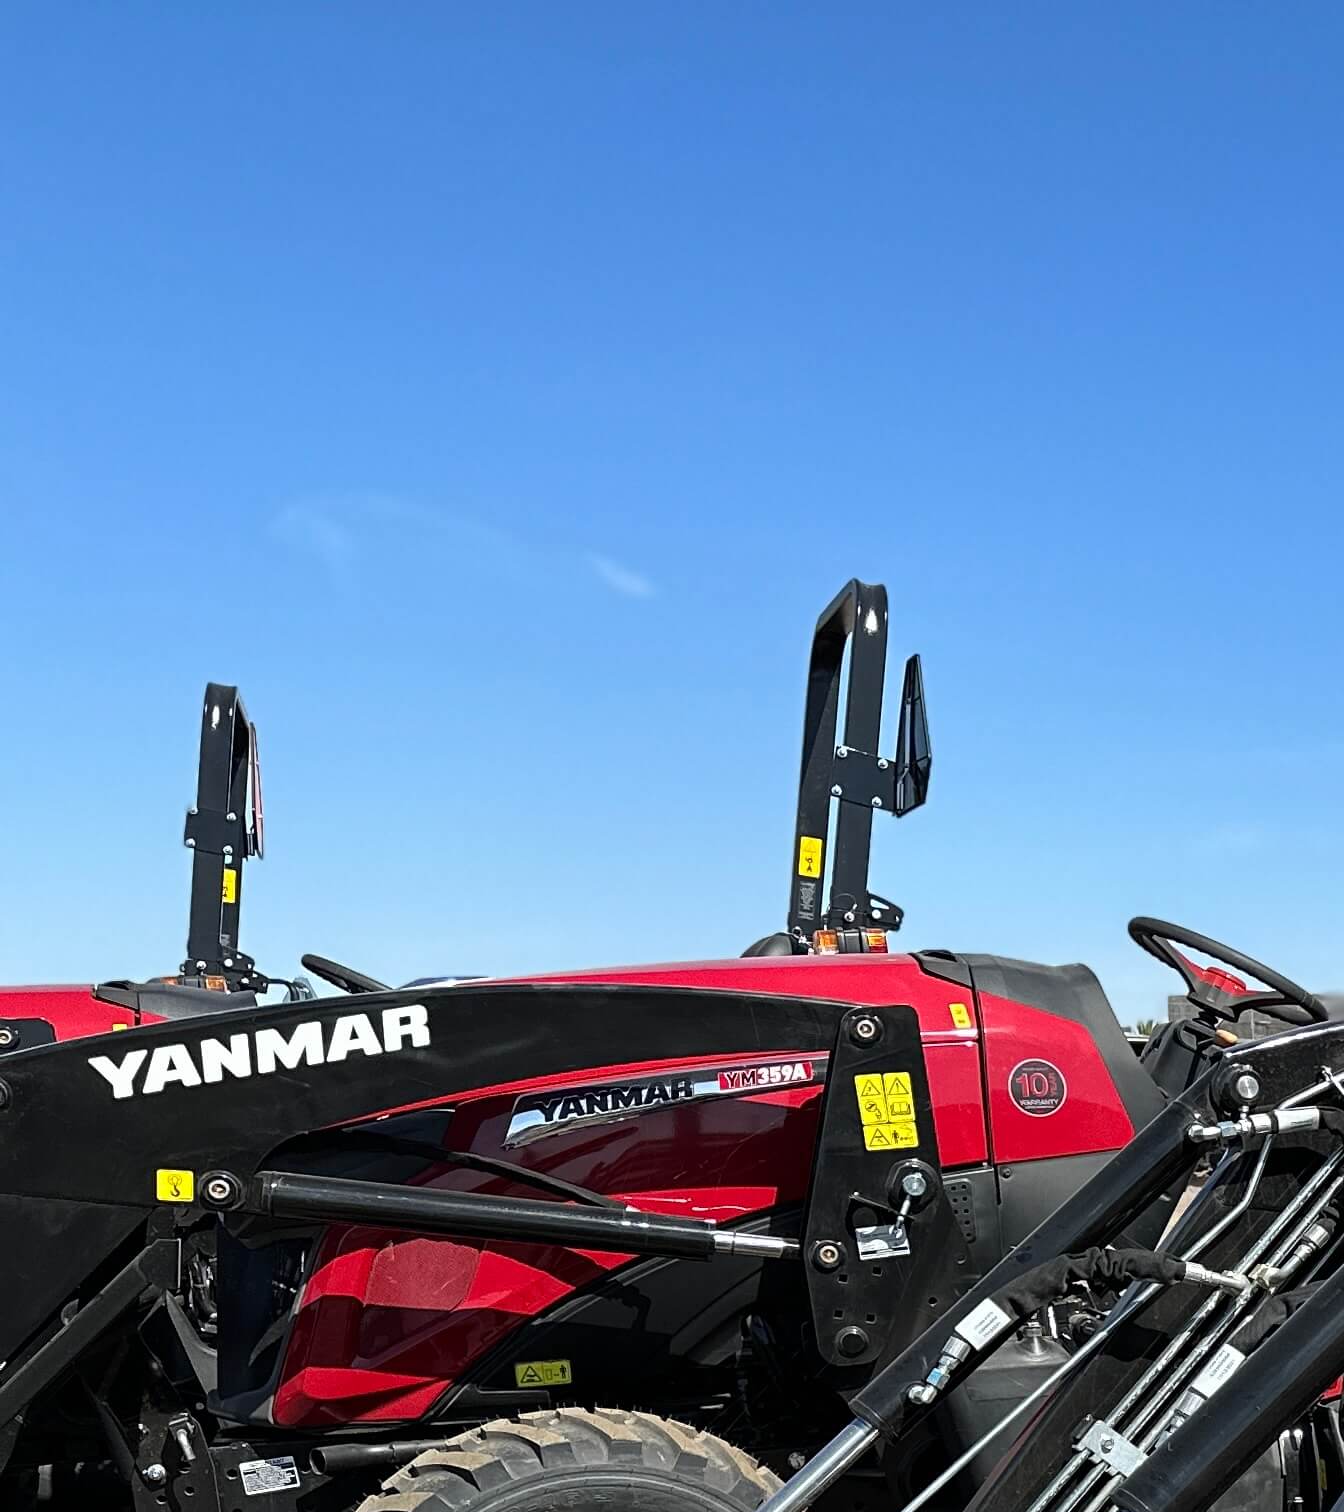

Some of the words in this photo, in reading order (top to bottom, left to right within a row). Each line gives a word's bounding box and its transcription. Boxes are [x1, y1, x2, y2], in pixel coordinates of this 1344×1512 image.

[87, 1004, 431, 1099] YANMAR
[534, 1078, 695, 1123] YANMAR
[724, 1062, 808, 1089] YM359A
[1015, 1072, 1049, 1098] 10
